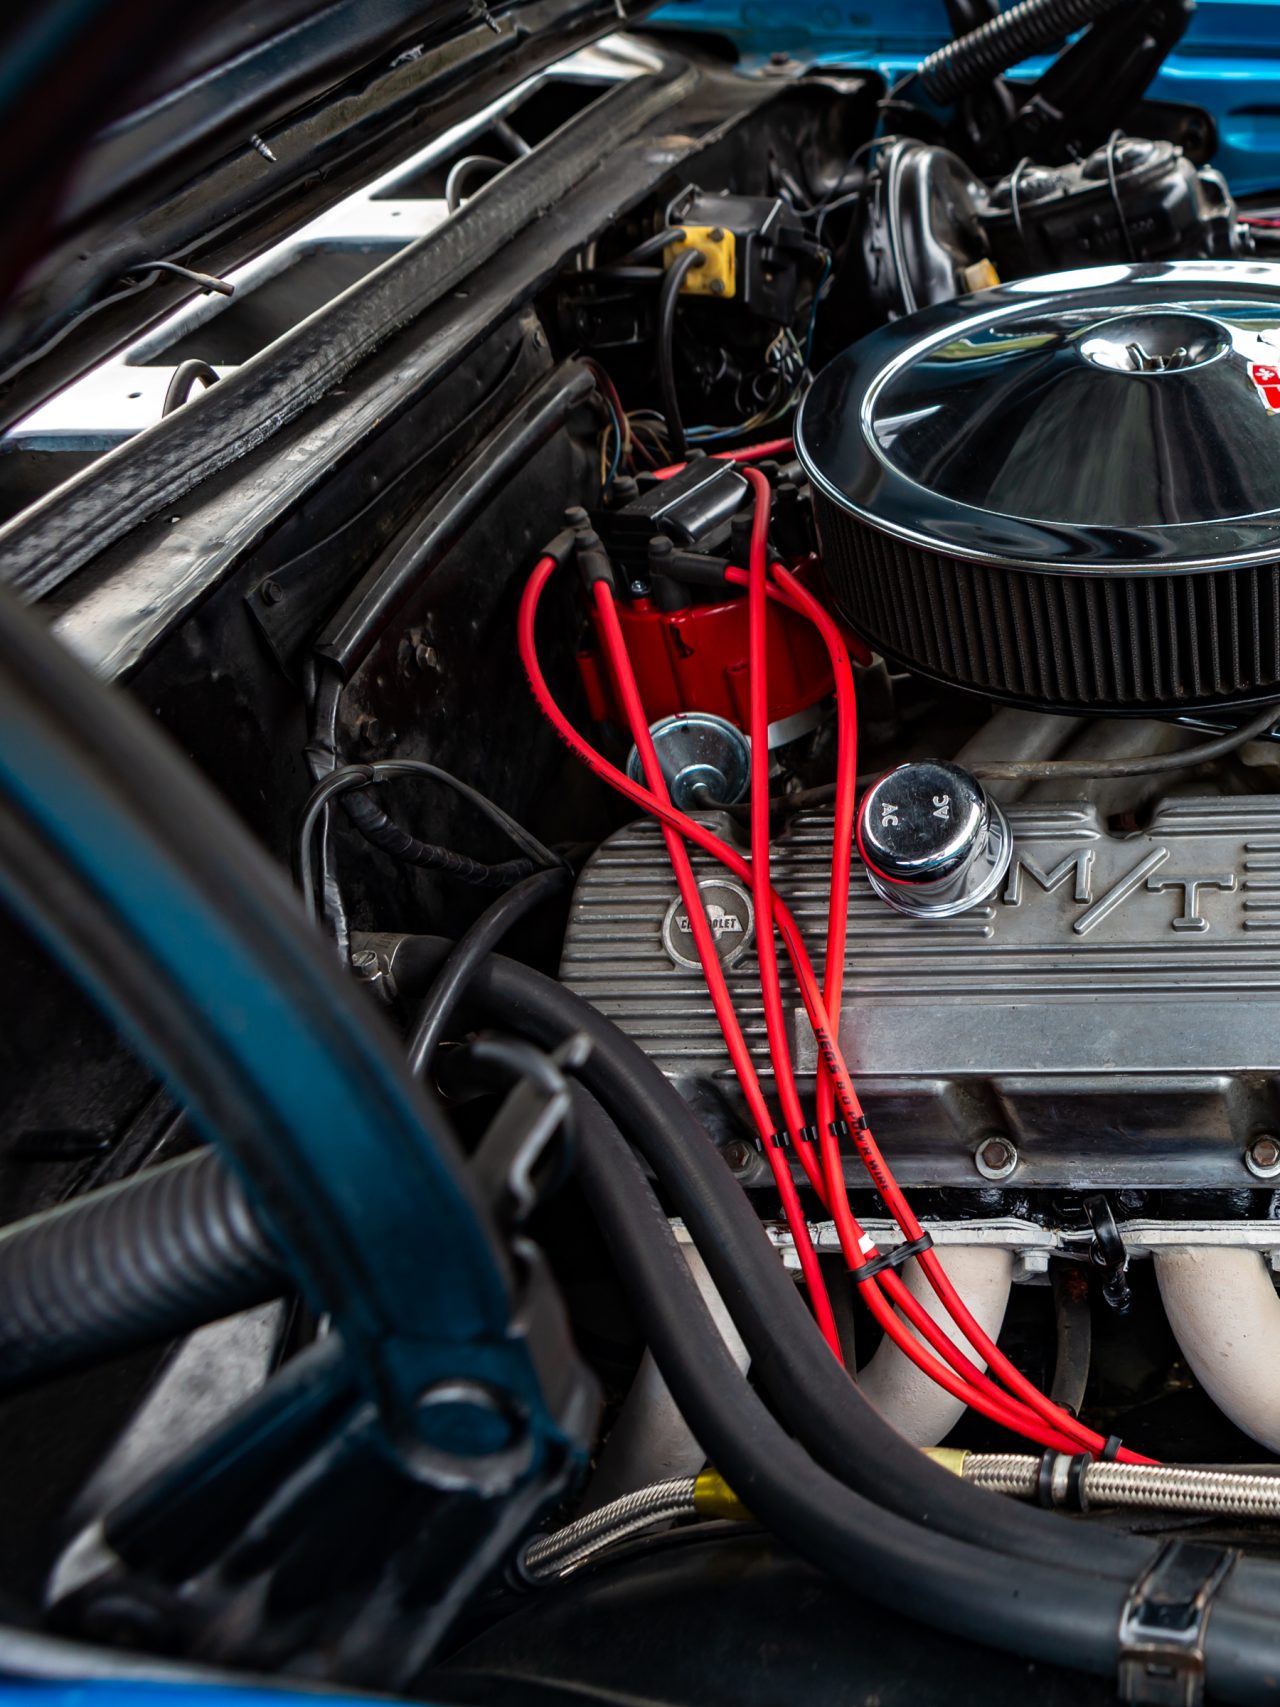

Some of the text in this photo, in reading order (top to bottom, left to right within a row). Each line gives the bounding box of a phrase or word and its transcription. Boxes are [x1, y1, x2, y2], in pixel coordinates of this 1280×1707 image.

[882, 803, 898, 827] AC
[933, 795, 949, 819] AC
[815, 1027, 839, 1074] JEGS
